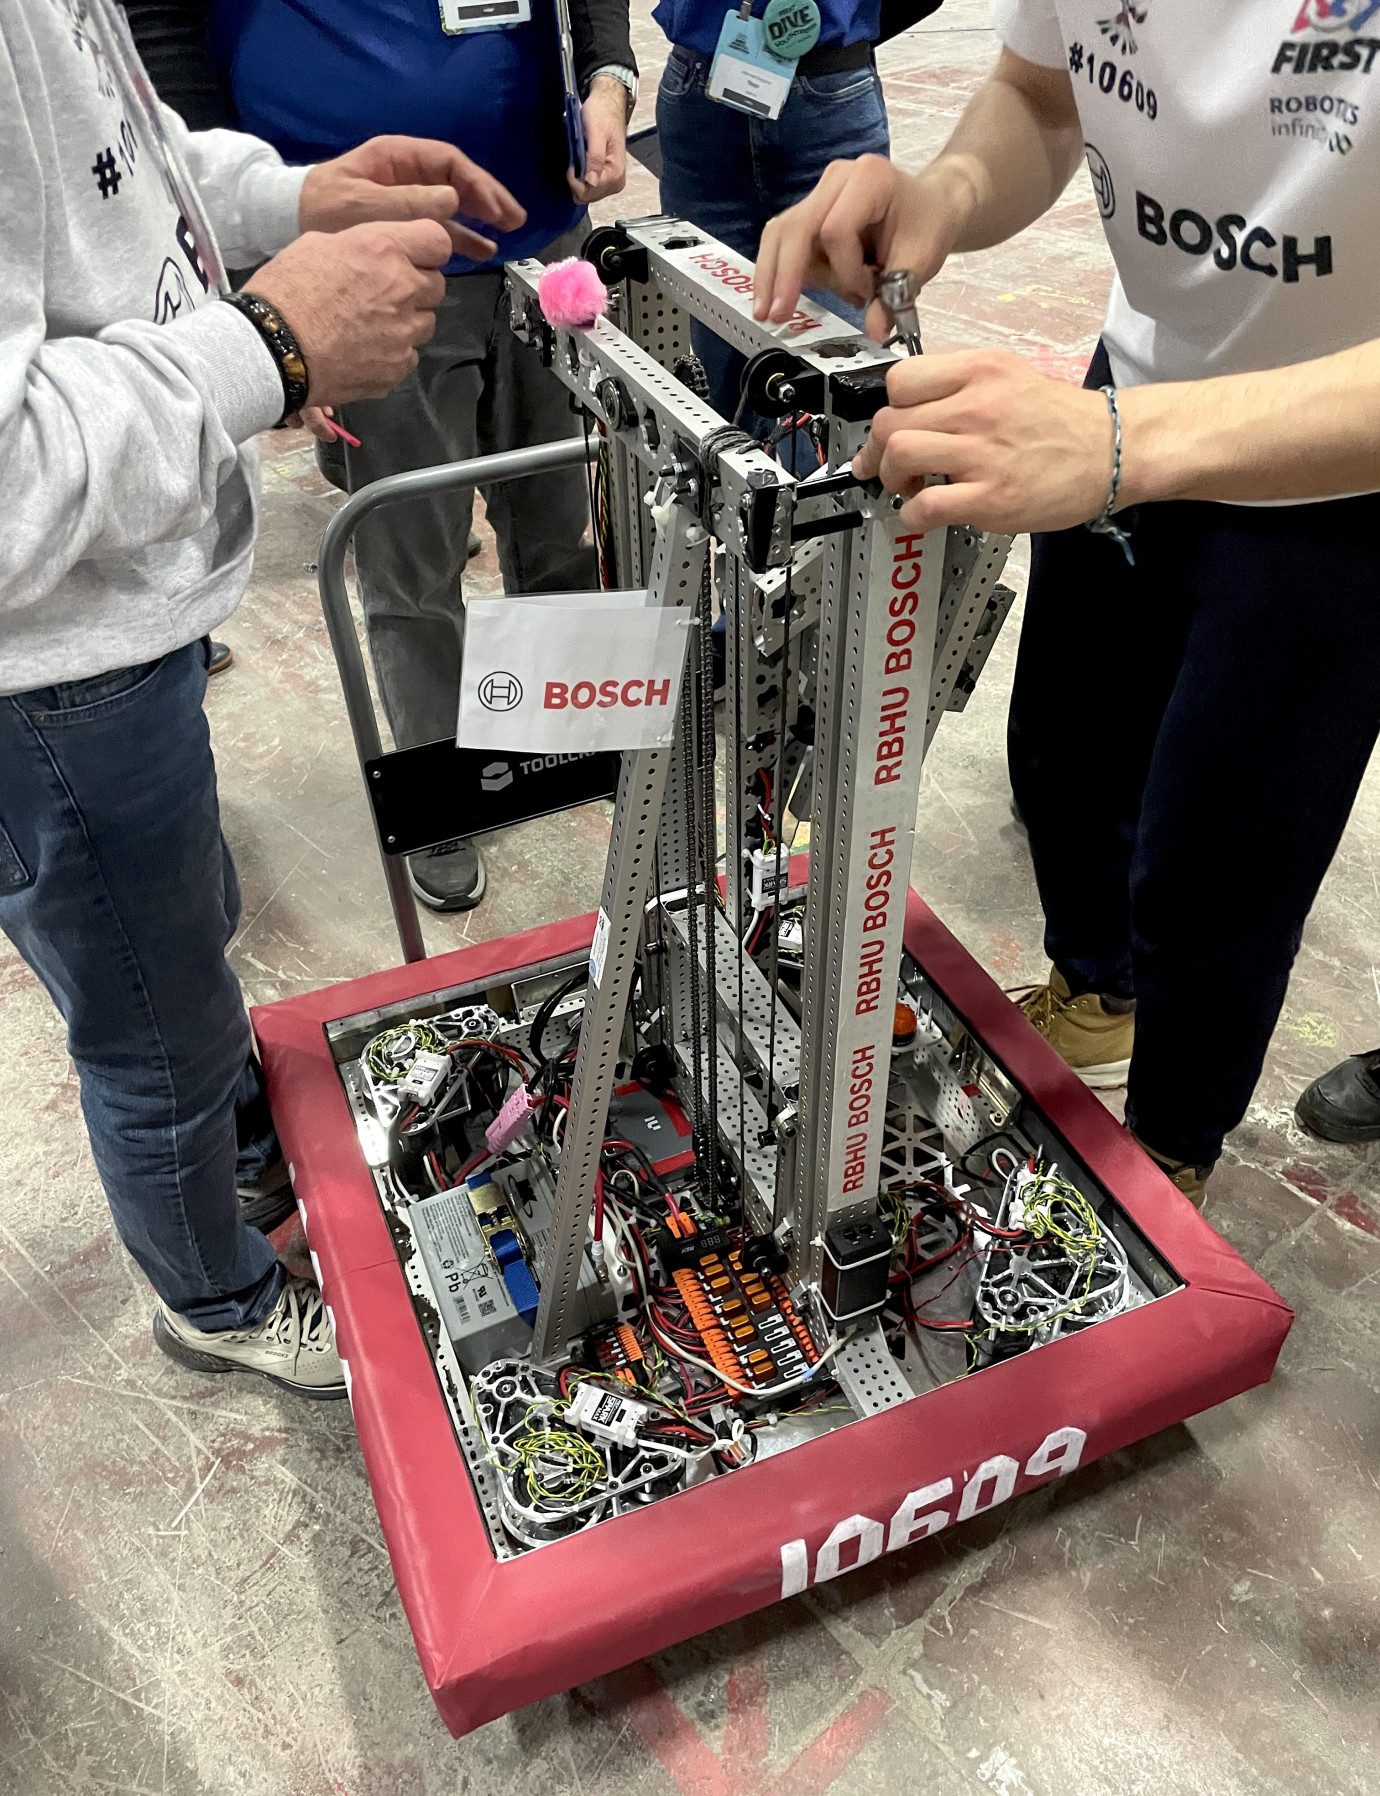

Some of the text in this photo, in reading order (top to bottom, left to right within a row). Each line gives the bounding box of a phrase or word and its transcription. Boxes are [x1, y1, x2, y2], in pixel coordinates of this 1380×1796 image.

[768, 5, 815, 40] DIVE
[1271, 38, 1380, 74] FIRST
[1068, 41, 1157, 121] #10609
[1136, 190, 1332, 283] BOSCH
[543, 679, 671, 710] BOSCH
[874, 533, 925, 786] RBHU BOSCH
[856, 826, 896, 1016] RBHU BOSCH
[843, 1044, 875, 1193] RBHU BOSCH
[445, 1272, 459, 1293] Pb
[598, 1395, 617, 1424] SPARK
[780, 1426, 1087, 1600] 10609
